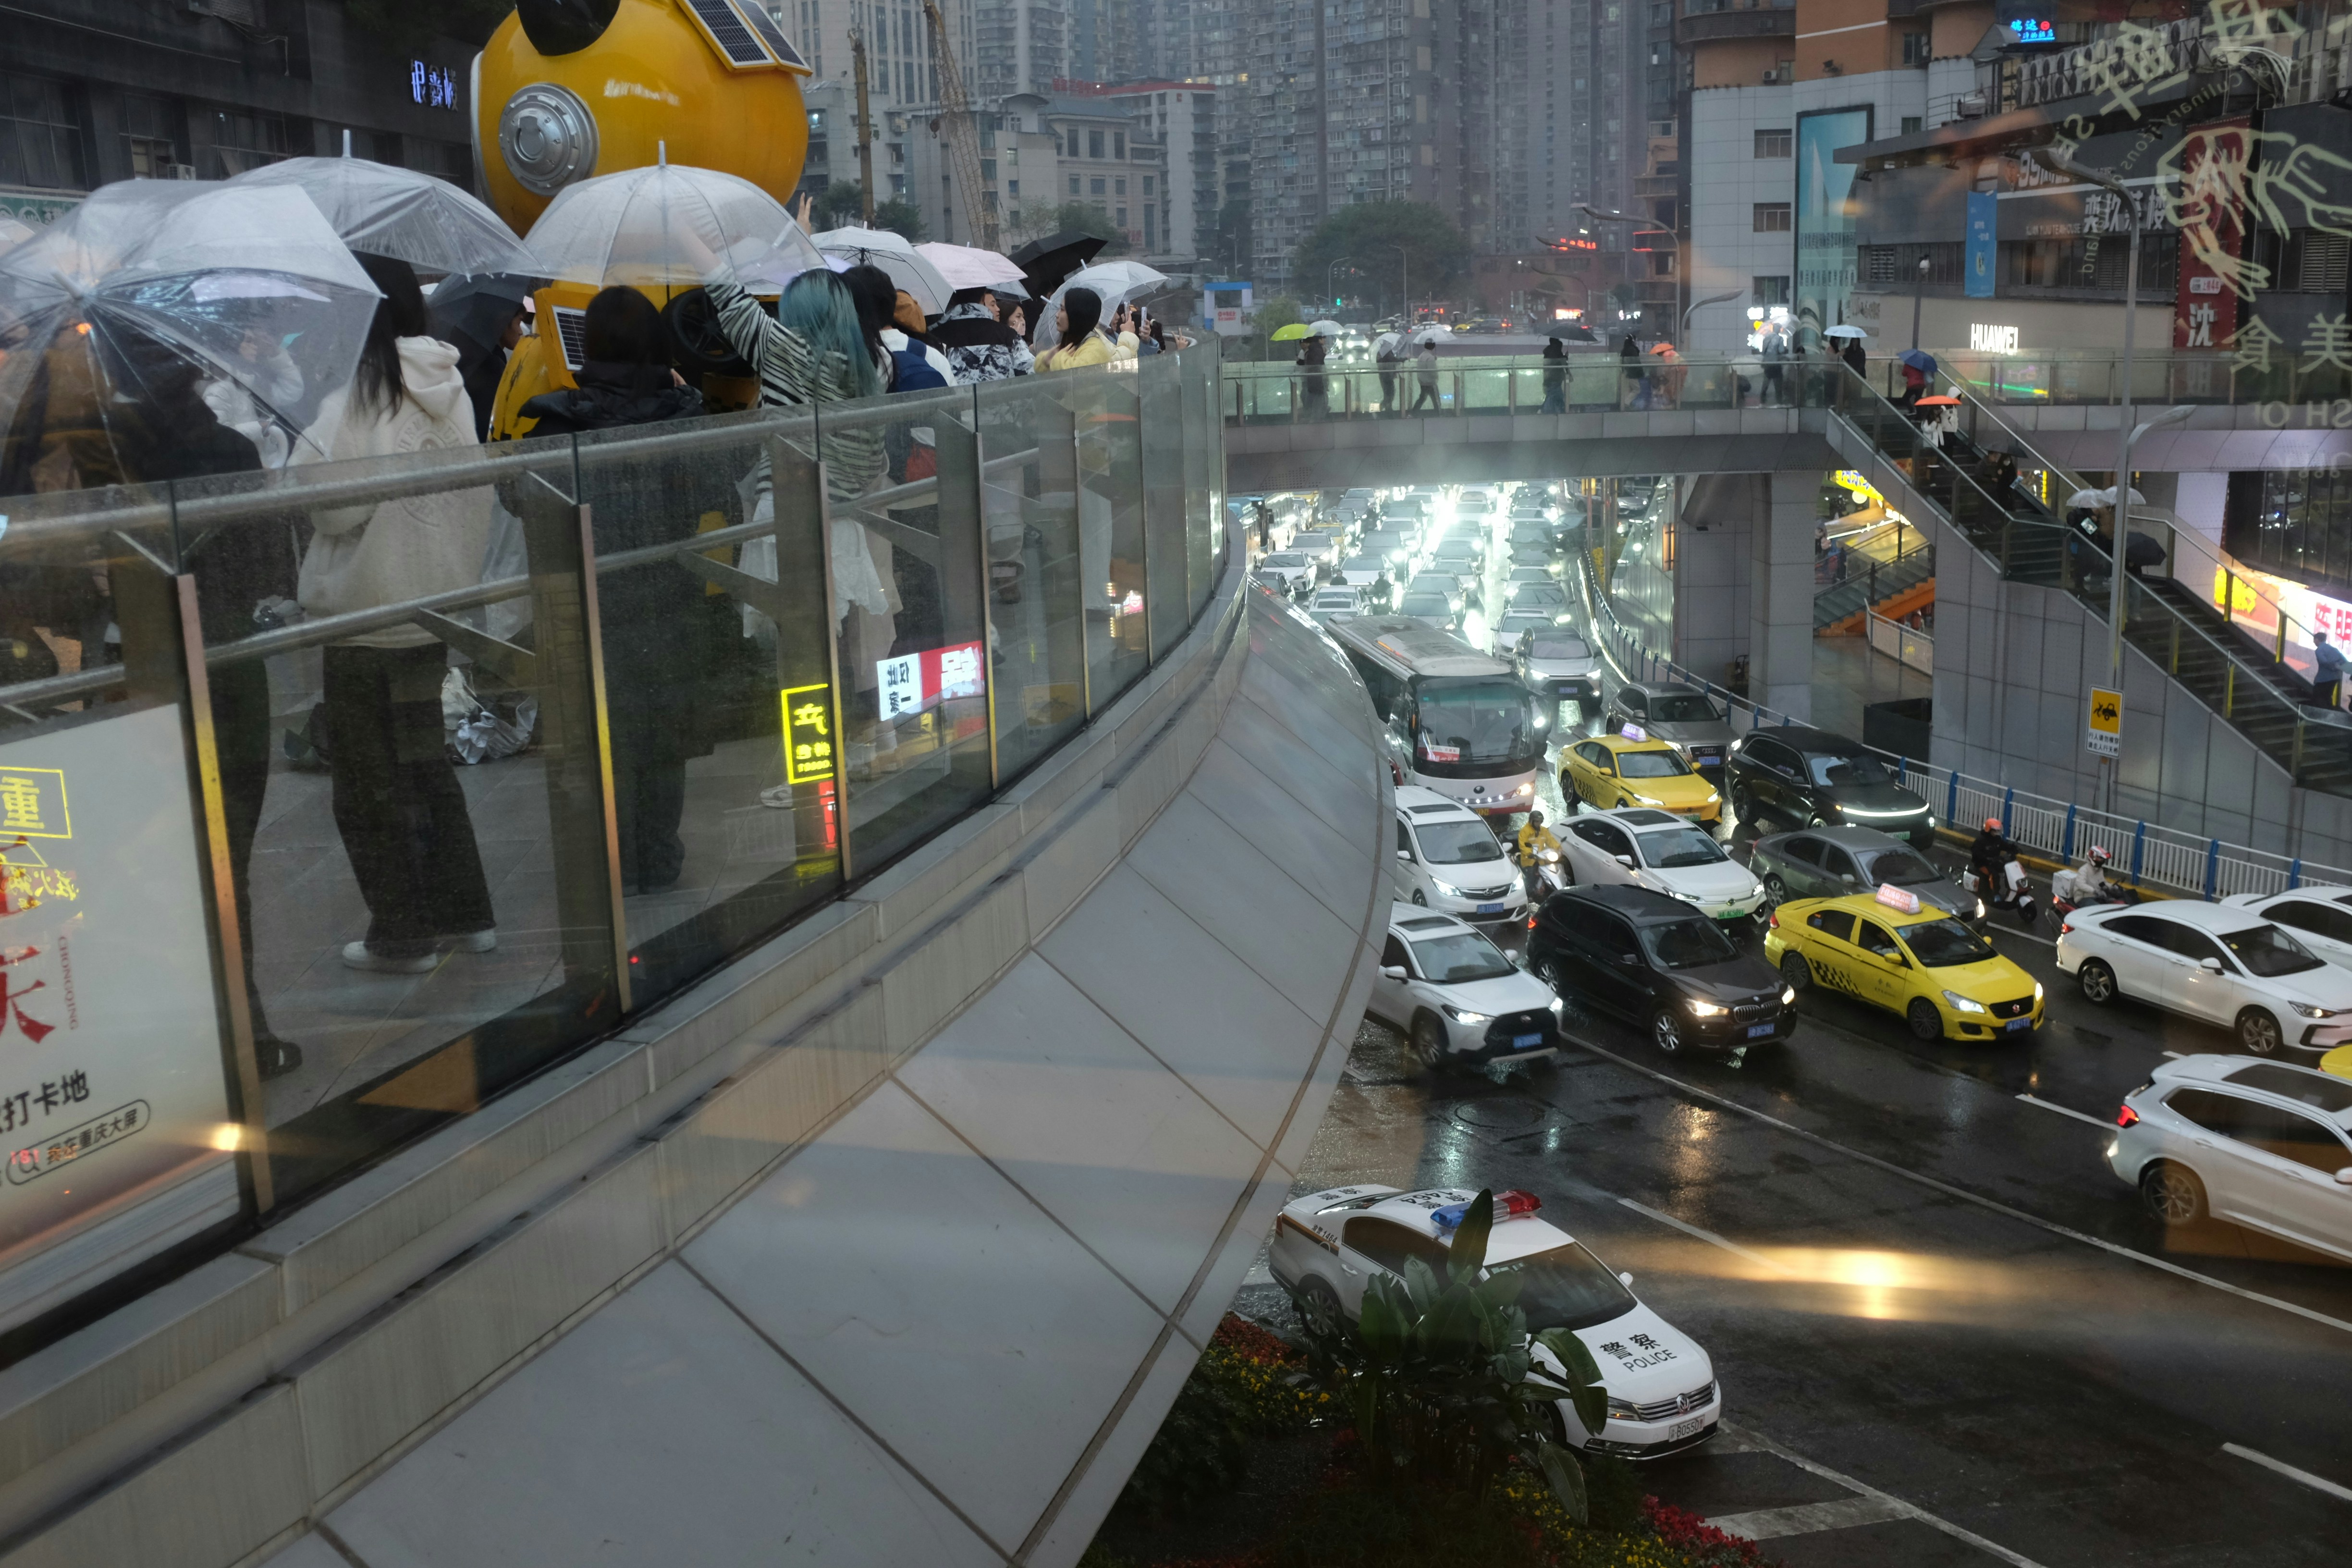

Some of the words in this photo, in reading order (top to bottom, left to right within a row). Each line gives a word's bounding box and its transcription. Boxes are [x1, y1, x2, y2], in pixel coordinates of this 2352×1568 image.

[1971, 323, 2018, 355] HUAWEI
[58, 936, 80, 1030] CHONGQING
[0, 1069, 90, 1134] 打卡地
[1598, 1333, 1661, 1360] 警察
[1621, 1348, 1678, 1373] POLICE
